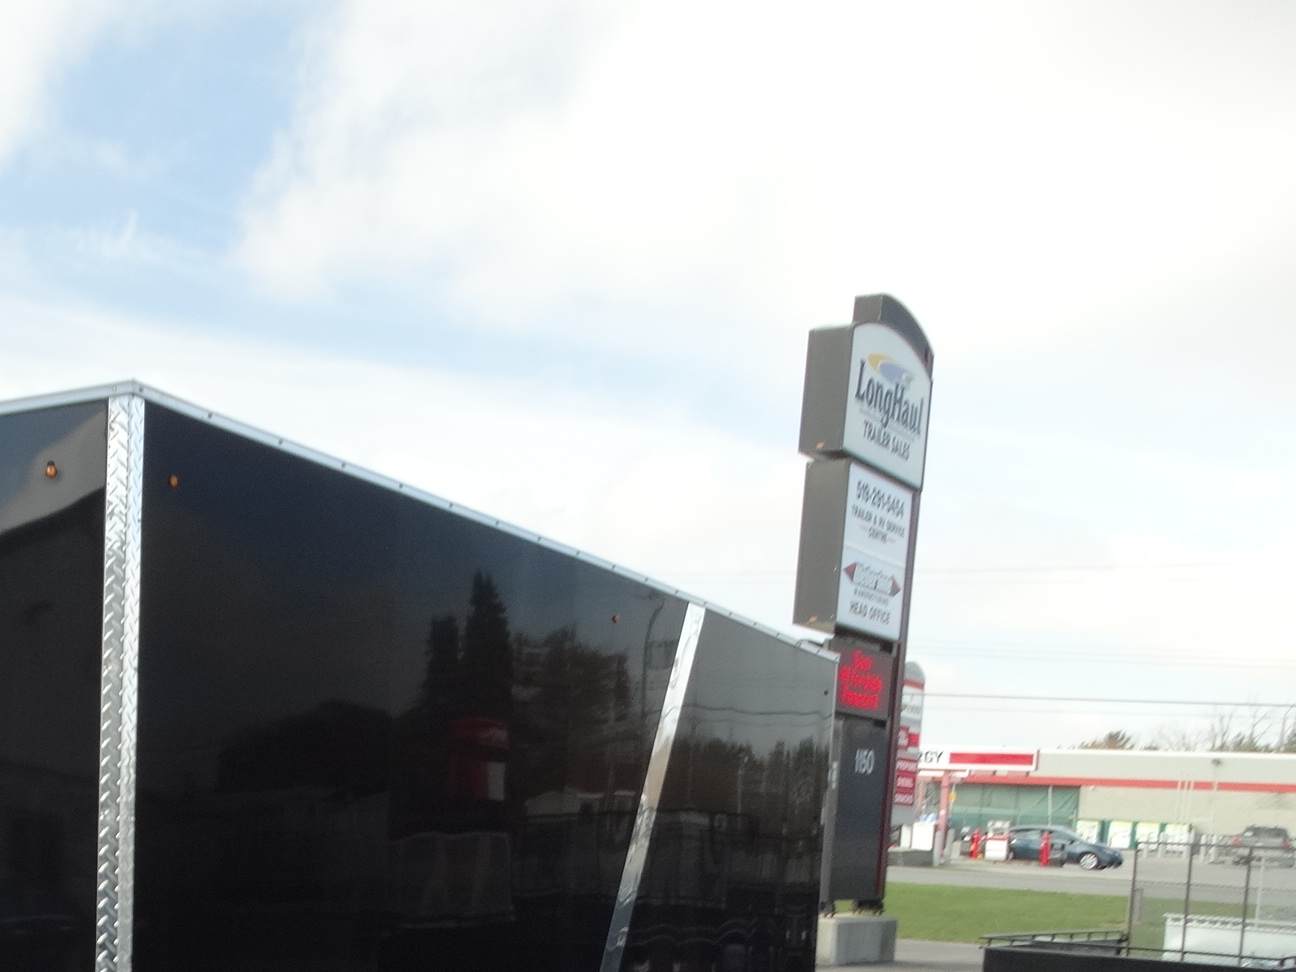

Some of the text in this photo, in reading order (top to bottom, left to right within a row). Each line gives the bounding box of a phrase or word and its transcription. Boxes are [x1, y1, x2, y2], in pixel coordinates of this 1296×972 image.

[855, 359, 924, 437] LongHaul
[863, 420, 911, 461] TRAILER SALES
